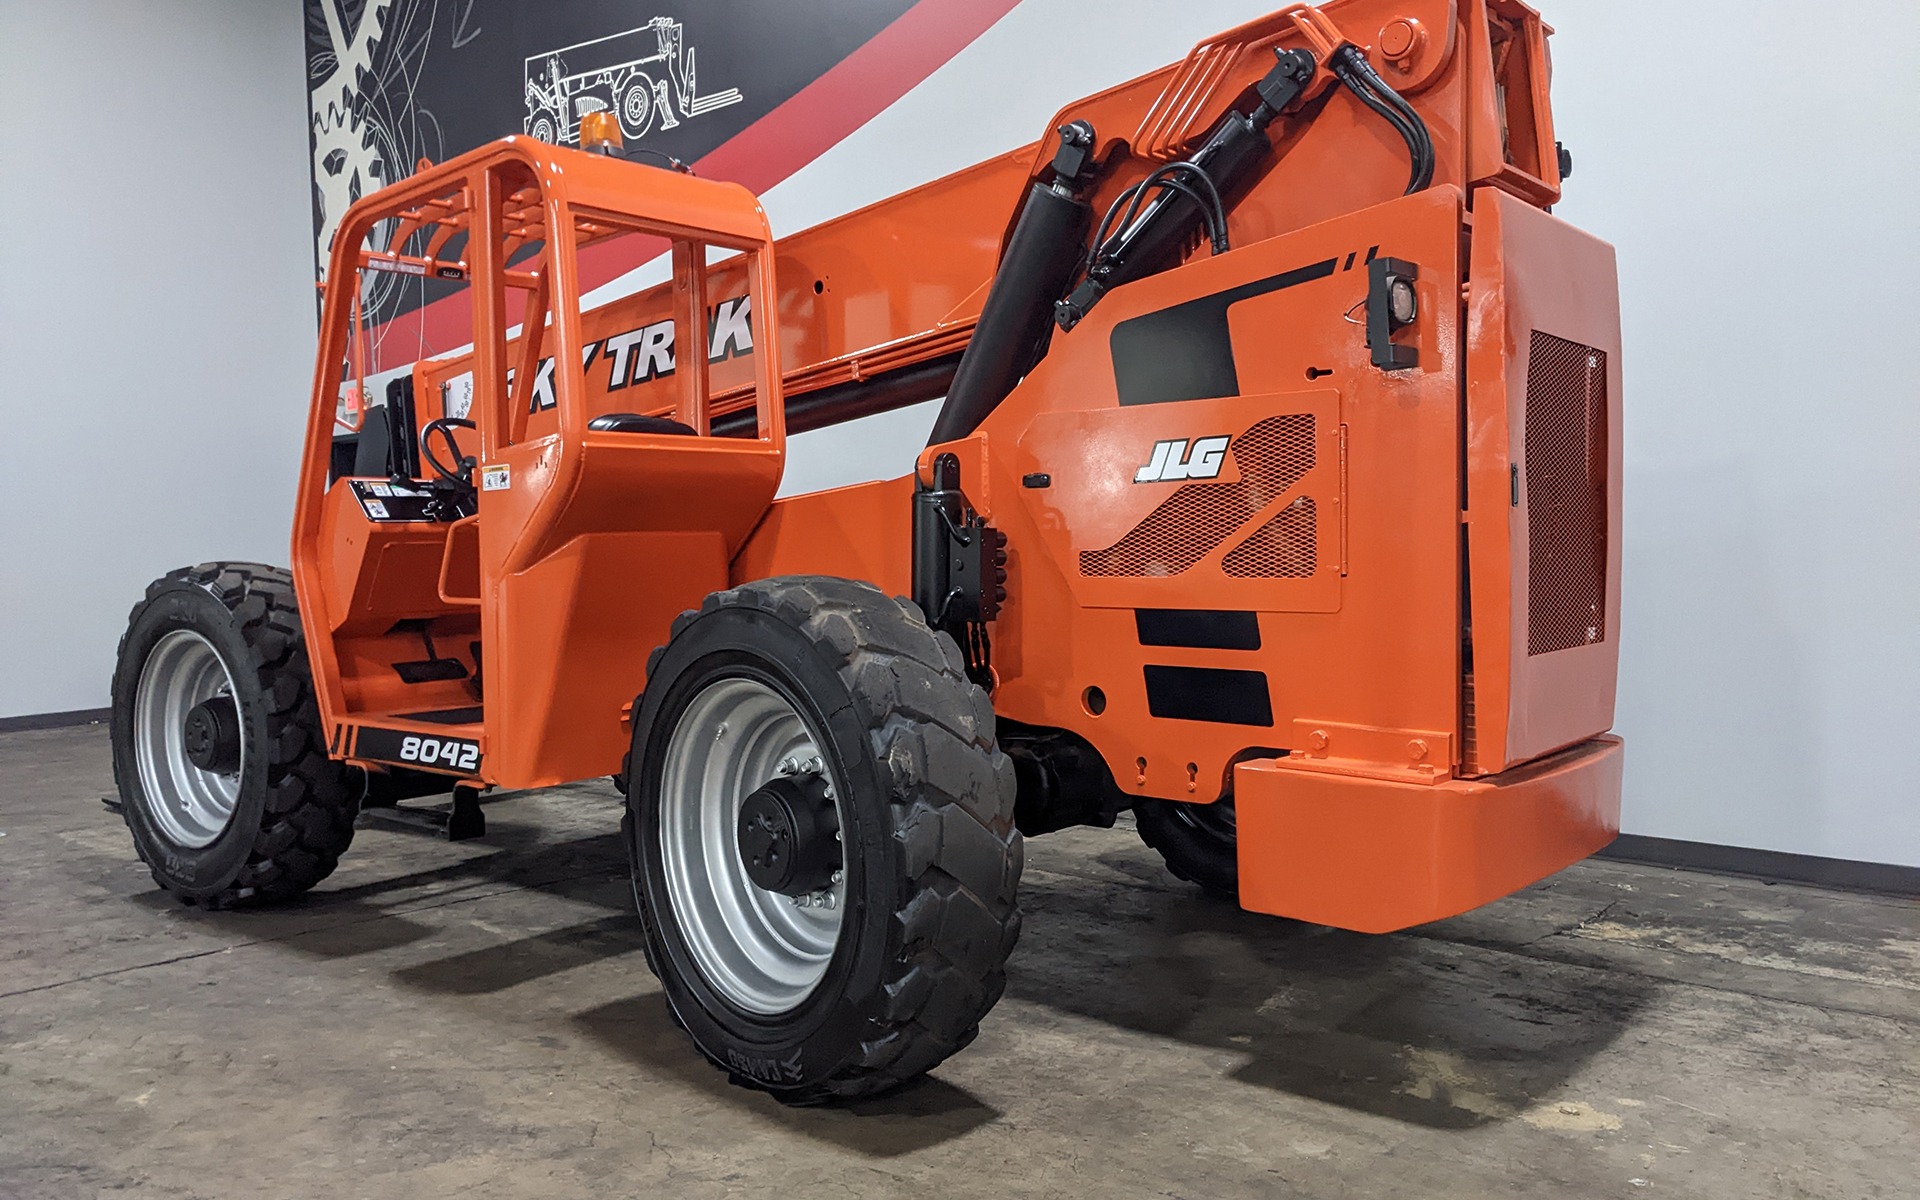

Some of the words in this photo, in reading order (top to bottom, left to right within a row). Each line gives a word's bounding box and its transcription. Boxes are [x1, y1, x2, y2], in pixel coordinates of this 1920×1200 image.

[604, 293, 753, 391] TRK
[1133, 435, 1232, 483] JLG
[400, 737, 479, 770] 8042
